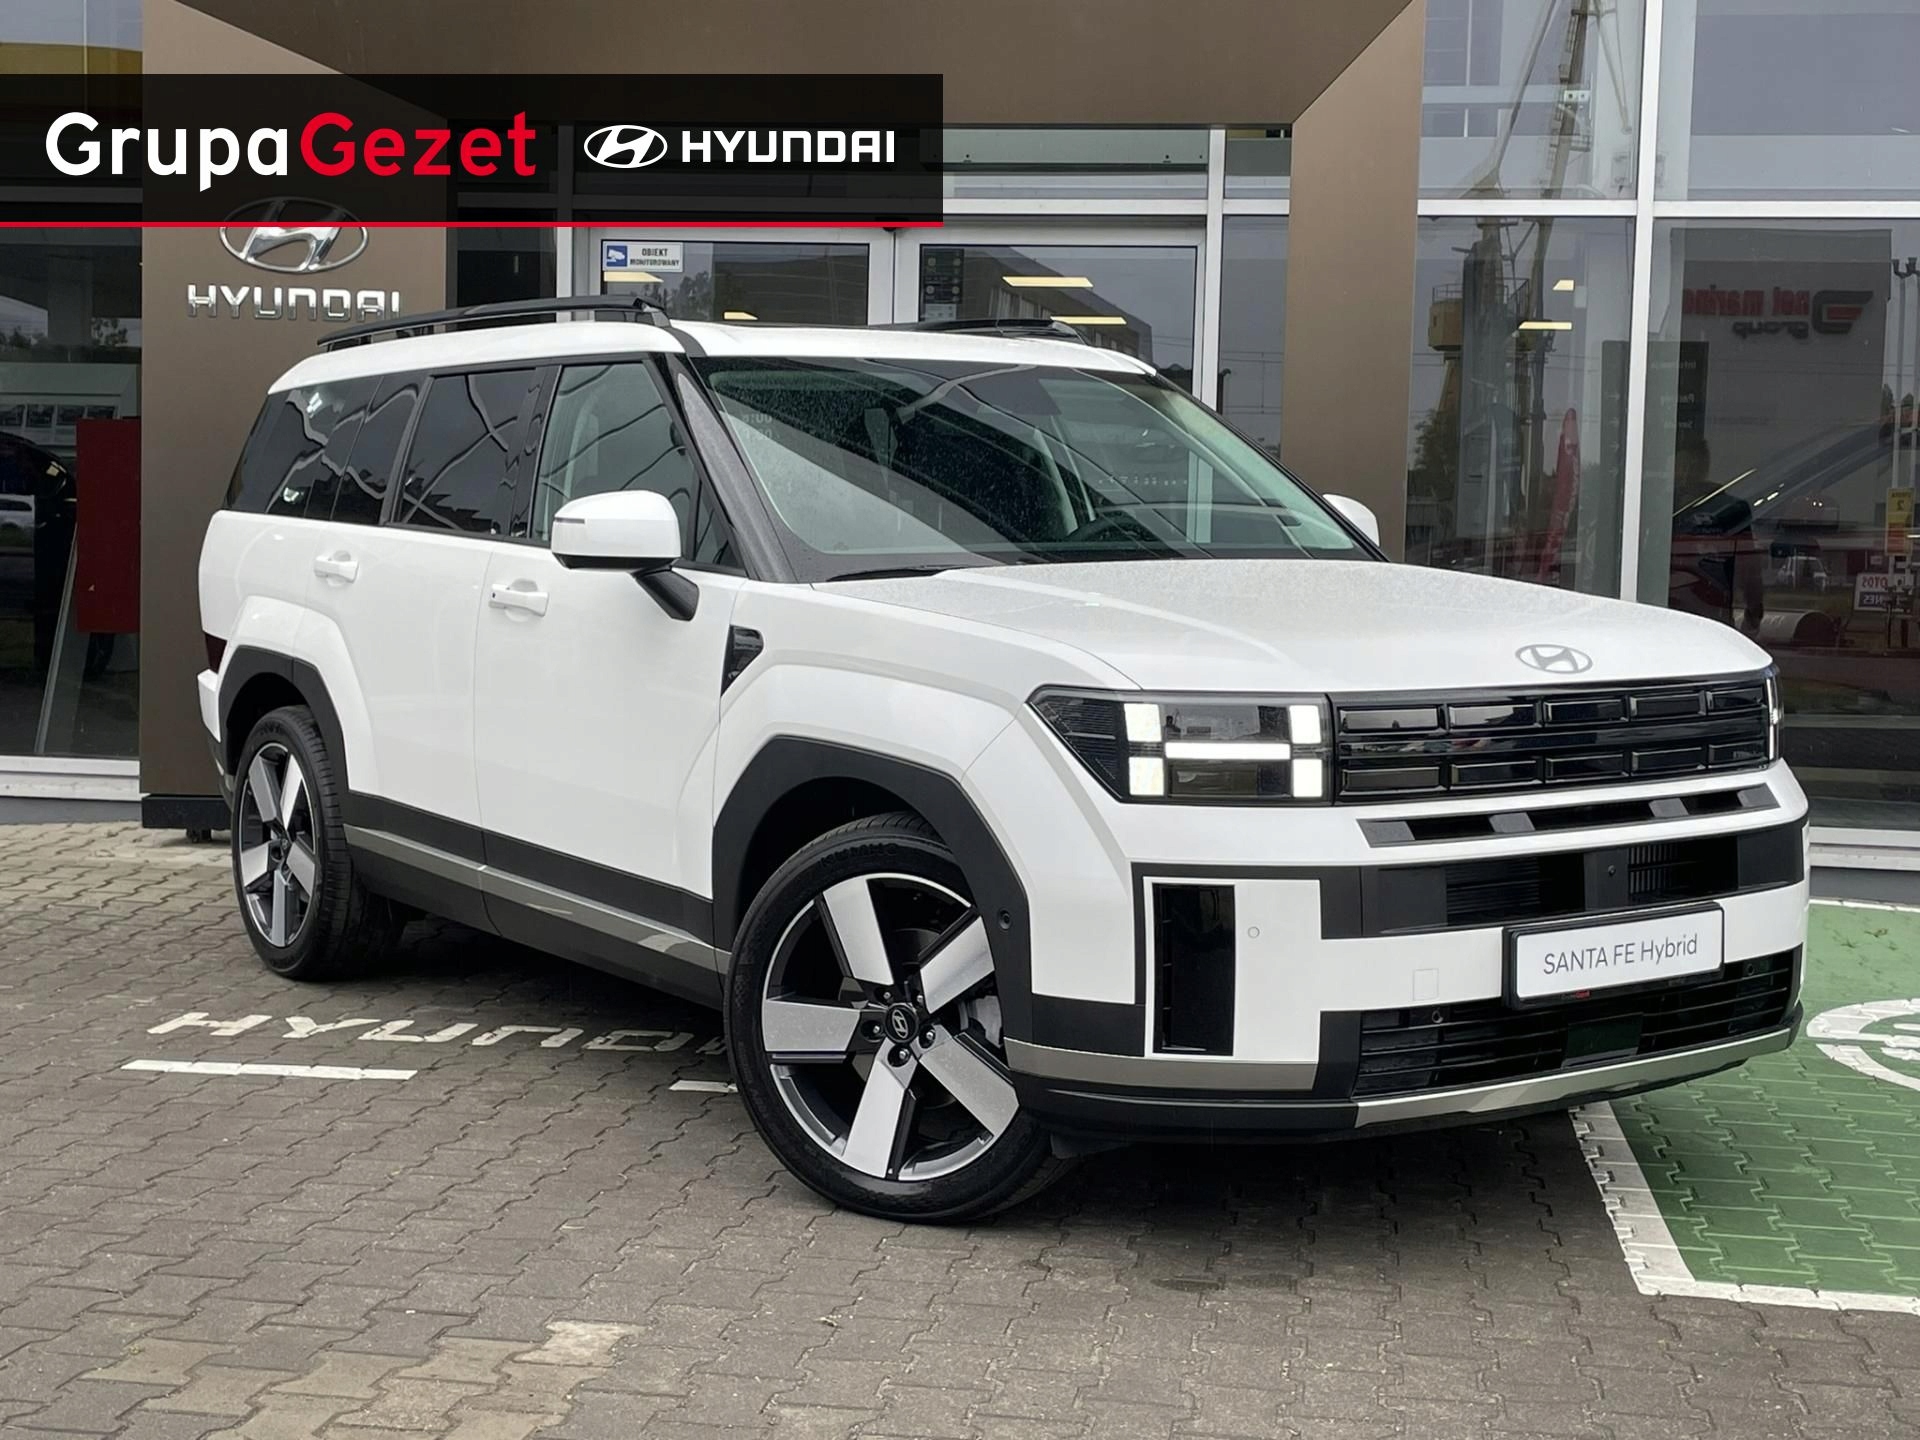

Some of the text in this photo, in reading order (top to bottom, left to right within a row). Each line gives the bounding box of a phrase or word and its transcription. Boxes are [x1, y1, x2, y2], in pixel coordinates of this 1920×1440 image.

[187, 284, 400, 322] HYUNDAI
[1543, 933, 1698, 975] SANTA FE Hybrid
[147, 1011, 726, 1055] HYUND
